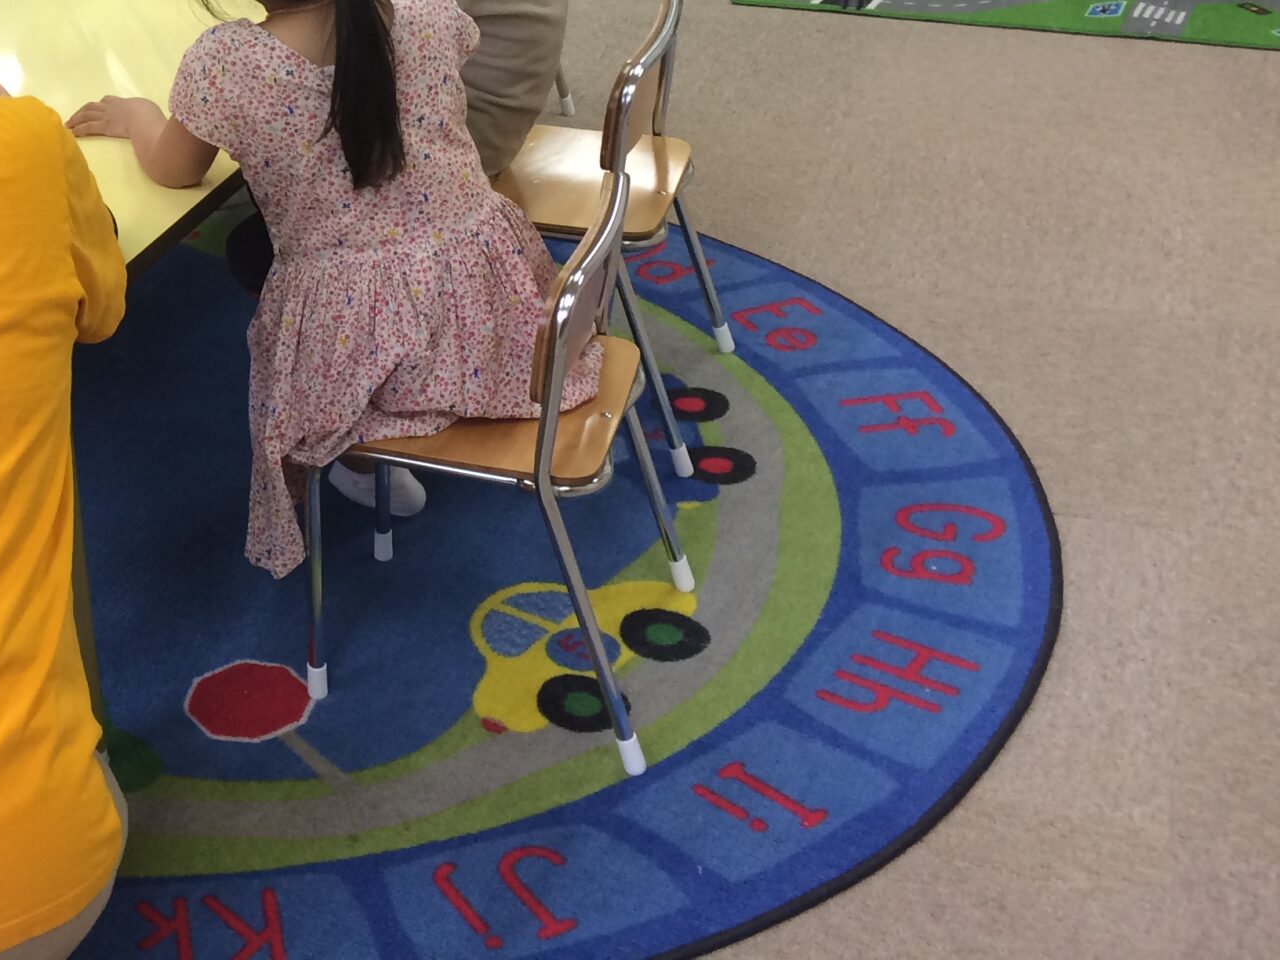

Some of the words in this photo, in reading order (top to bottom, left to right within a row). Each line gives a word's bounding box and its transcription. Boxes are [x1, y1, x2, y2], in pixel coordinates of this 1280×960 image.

[731, 296, 823, 352] Ee
[839, 390, 956, 437] Ff
[878, 502, 1007, 585] Gg
[815, 629, 981, 714] Hh
[691, 760, 829, 833] Ii
[432, 845, 578, 949] Jj
